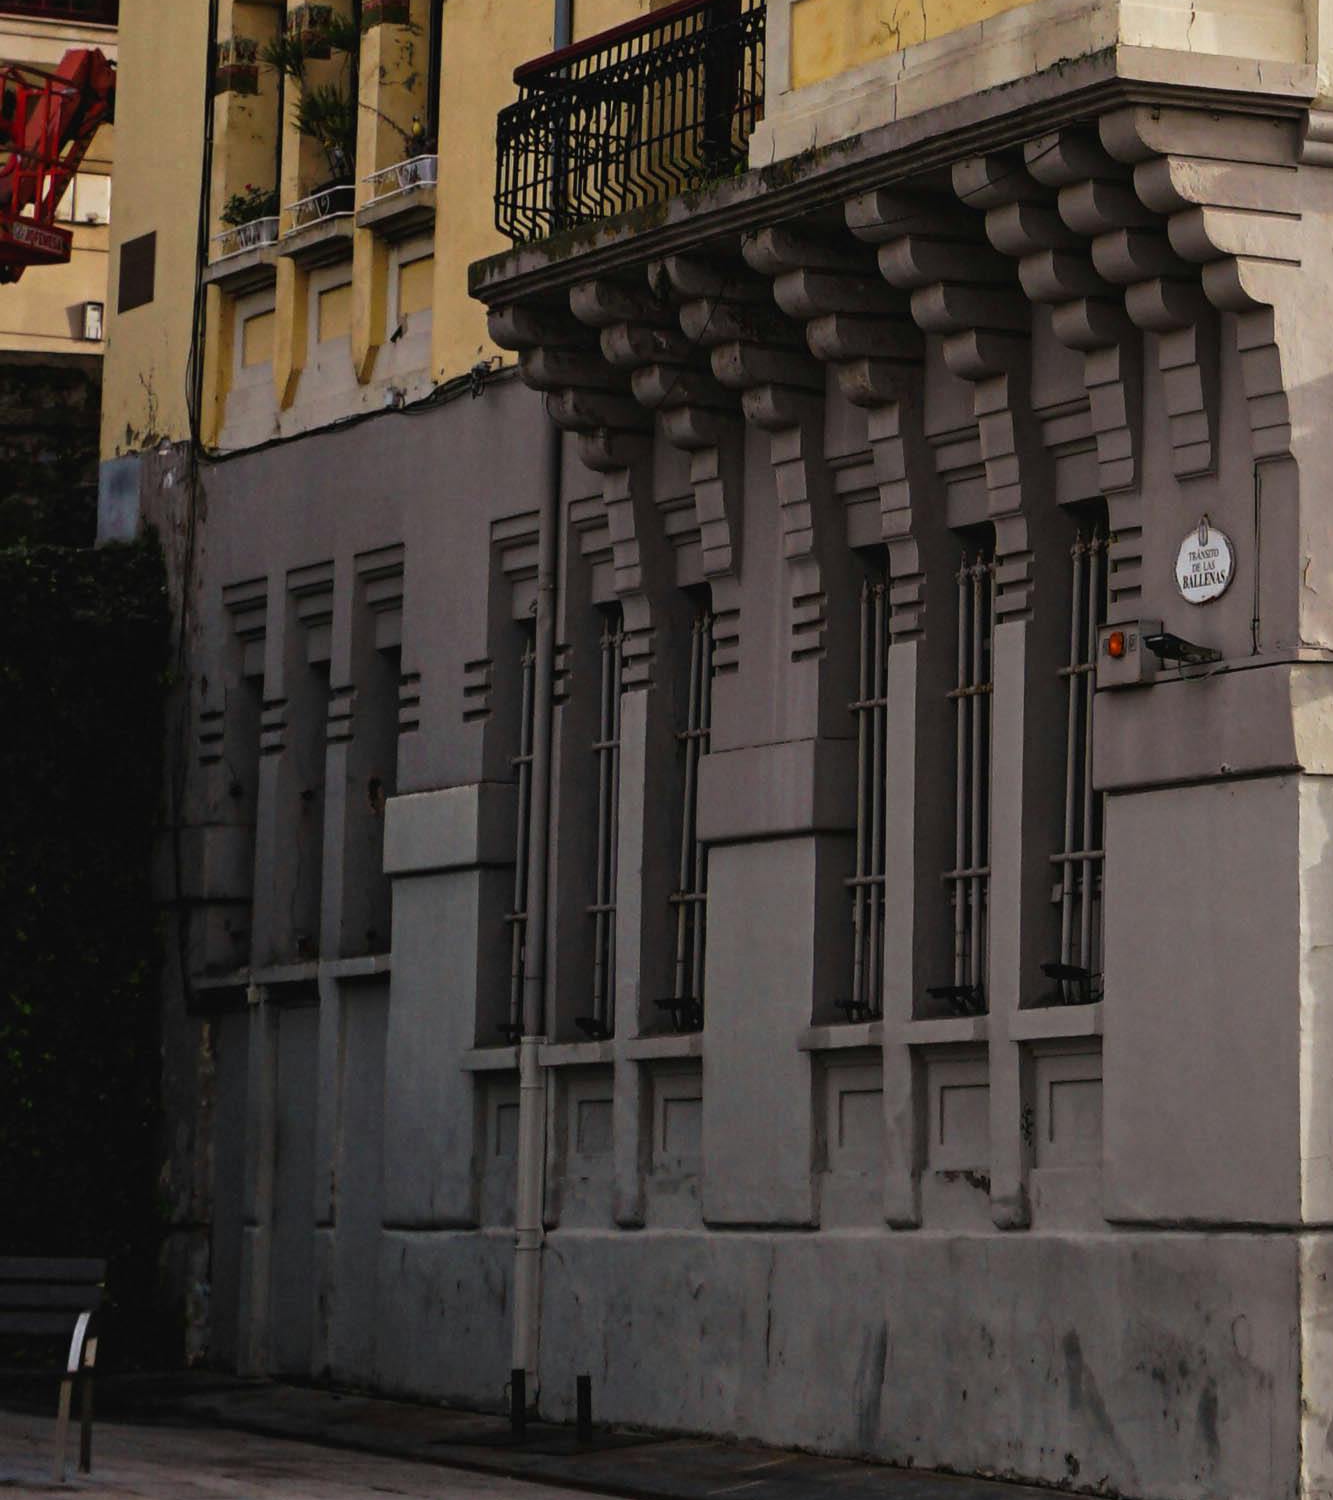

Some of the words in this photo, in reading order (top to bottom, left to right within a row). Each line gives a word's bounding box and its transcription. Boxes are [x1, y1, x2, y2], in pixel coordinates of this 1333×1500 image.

[1188, 548, 1219, 562] TRÁNSITO
[1192, 562, 1201, 573] DE
[1203, 560, 1216, 571] LAS
[1183, 569, 1226, 589] BALLENAS
